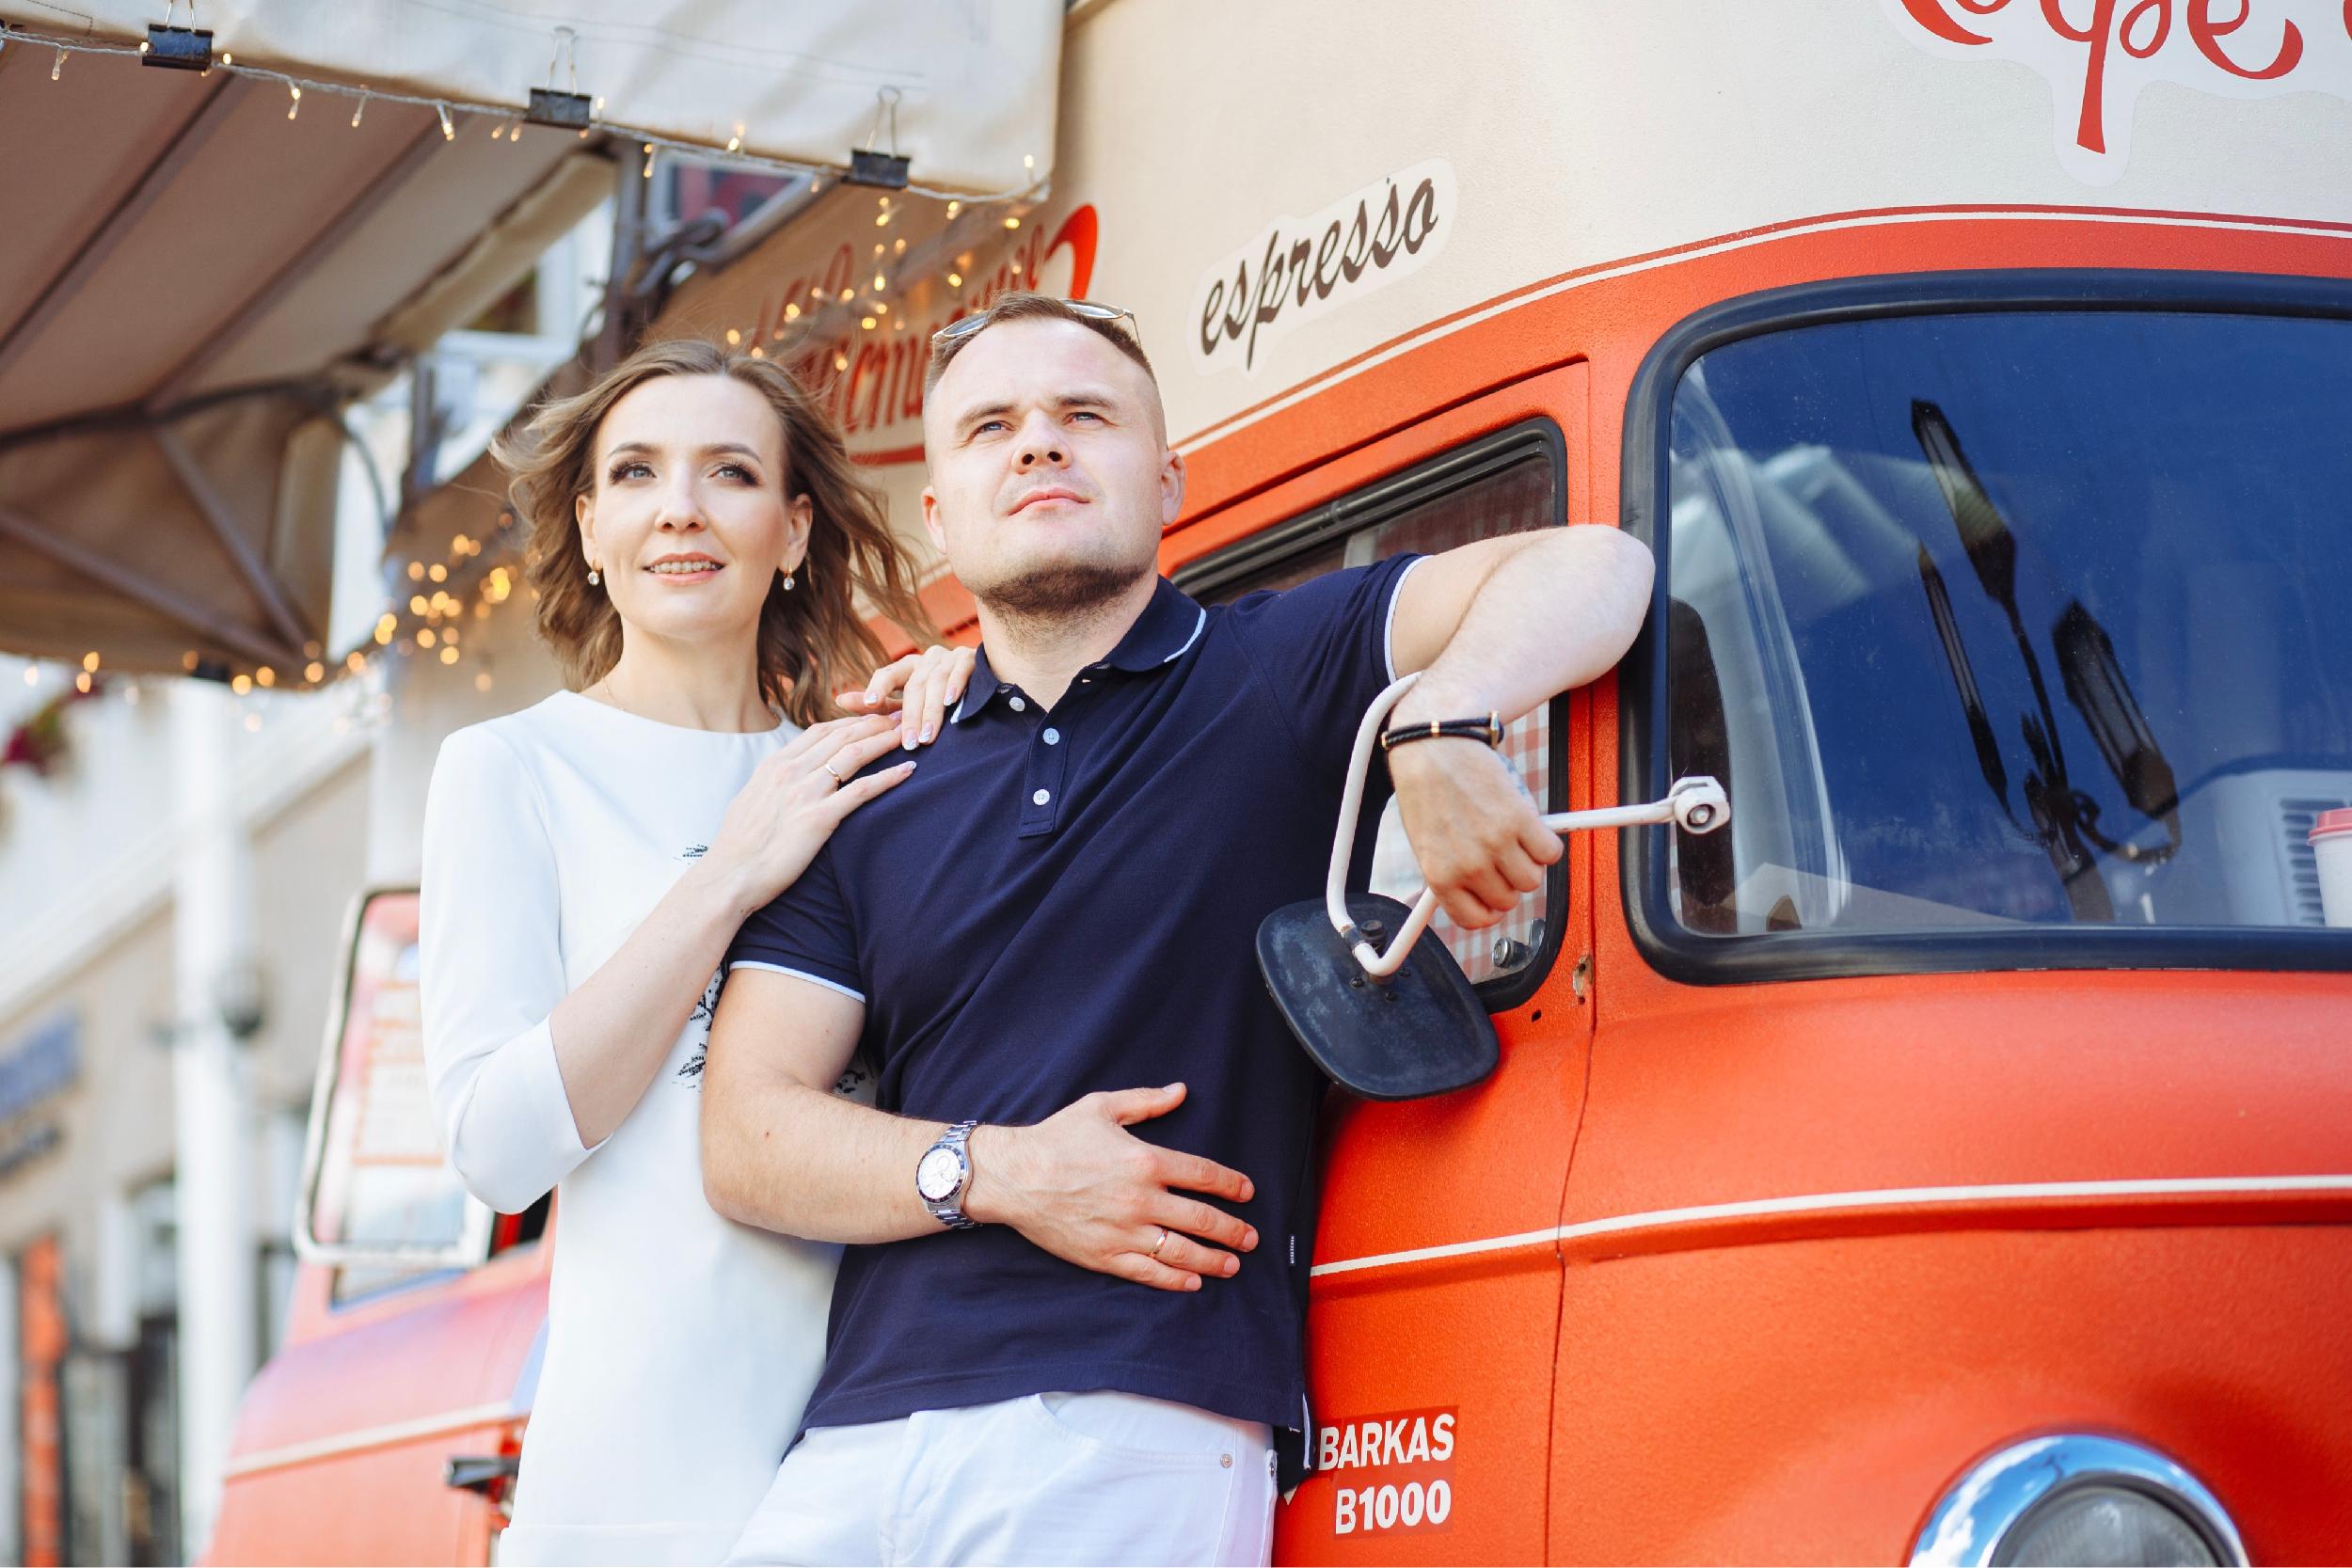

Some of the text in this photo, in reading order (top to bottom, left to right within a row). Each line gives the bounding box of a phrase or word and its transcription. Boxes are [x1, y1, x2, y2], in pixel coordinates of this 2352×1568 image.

[1200, 178, 1438, 371] espresso
[1318, 1413, 1455, 1470] BARKAS
[1335, 1480, 1452, 1534] B1000
